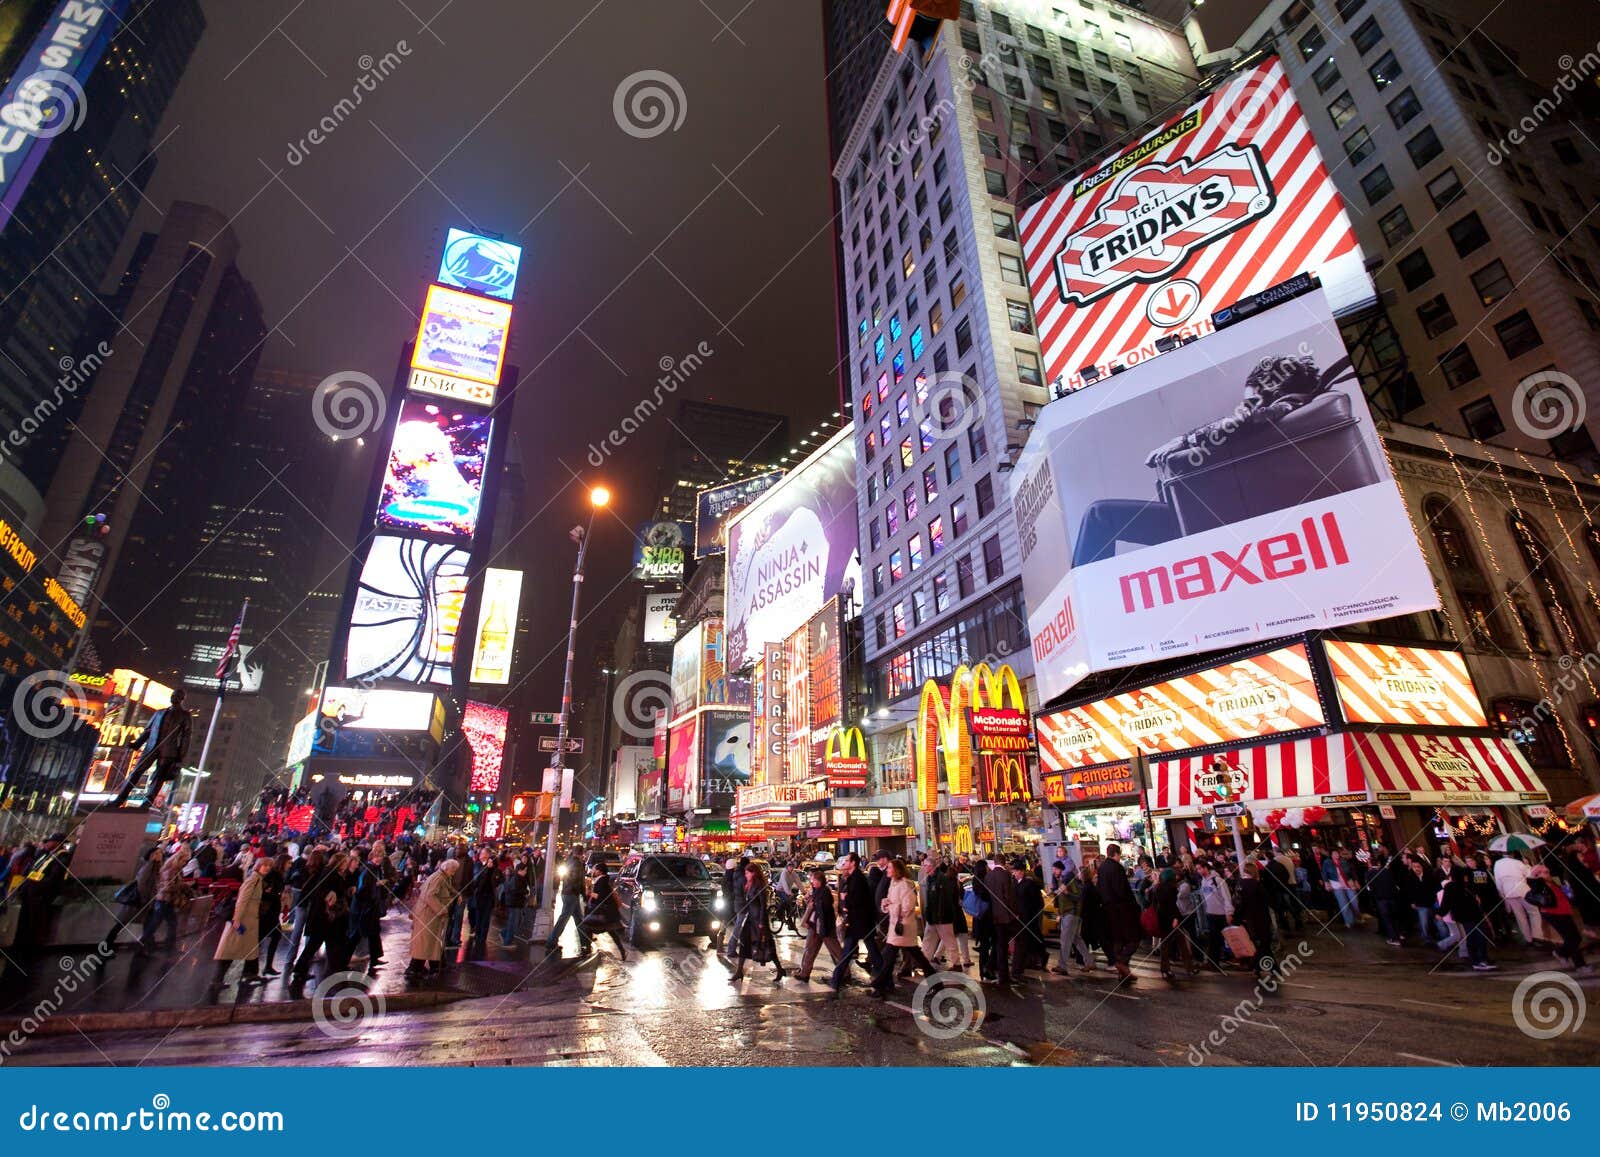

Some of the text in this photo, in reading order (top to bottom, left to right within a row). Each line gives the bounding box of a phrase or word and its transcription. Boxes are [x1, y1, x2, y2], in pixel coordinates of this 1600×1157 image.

[1130, 197, 1166, 220] T.G.I.
[1069, 359, 1119, 390] HRE
[1127, 343, 1155, 366] ON
[758, 544, 799, 587] NINJA
[1119, 511, 1350, 614] maxell
[750, 555, 820, 615] ASSASSIN
[1266, 602, 1394, 628] HEADPHONES PARTNERSHIPS
[1332, 594, 1400, 612] TECHNOLOGICAL
[1033, 596, 1076, 664] maxell
[1204, 626, 1250, 640] ACCESSORIES
[1161, 642, 1189, 652] STORAGE
[771, 651, 781, 755] PALACE
[974, 715, 1028, 727] McDonald's
[983, 725, 1020, 733] Restaurant
[1047, 780, 1062, 798] 47
